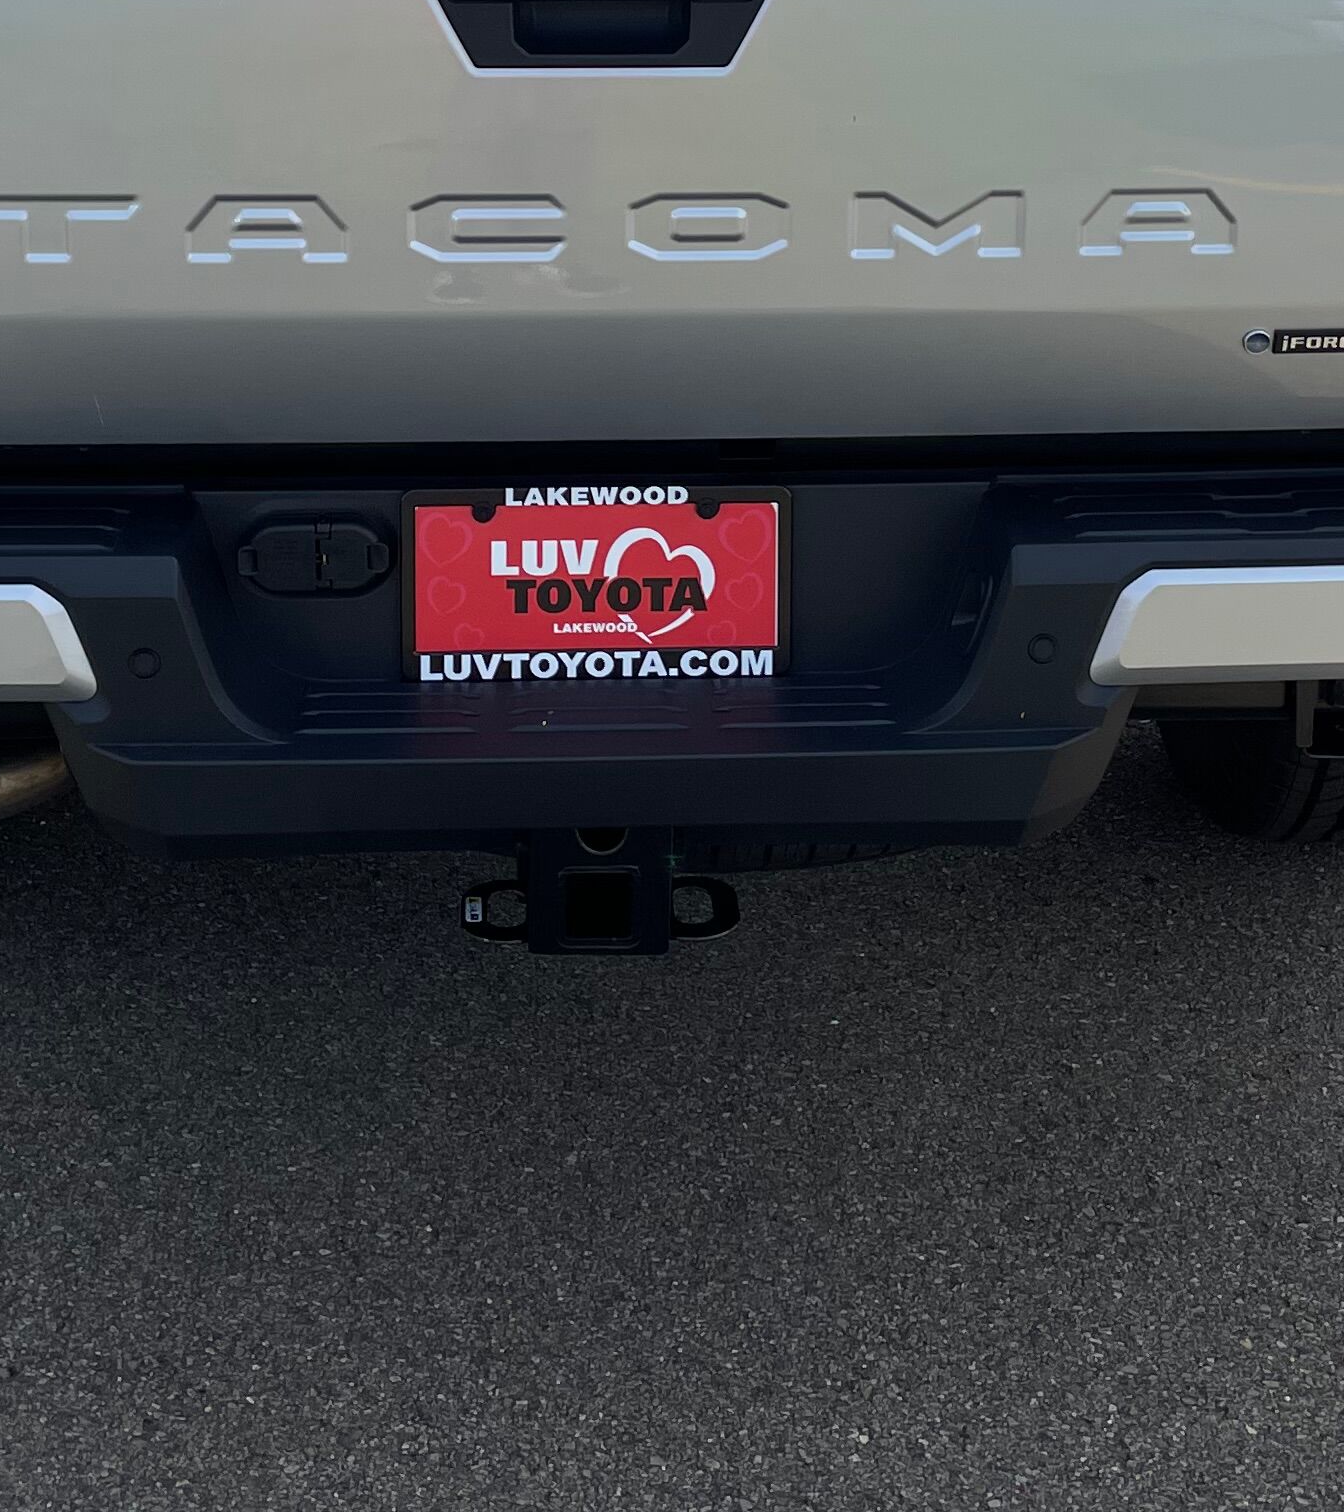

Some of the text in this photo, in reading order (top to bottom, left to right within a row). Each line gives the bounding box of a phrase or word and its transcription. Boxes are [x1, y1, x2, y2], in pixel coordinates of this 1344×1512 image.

[505, 486, 689, 506] LAKEWOOD
[490, 539, 599, 576] LUV
[506, 577, 707, 613] TOYOTA
[553, 621, 638, 634] LAKEWOOD
[419, 649, 774, 681] LUVTOYOTA.COM
